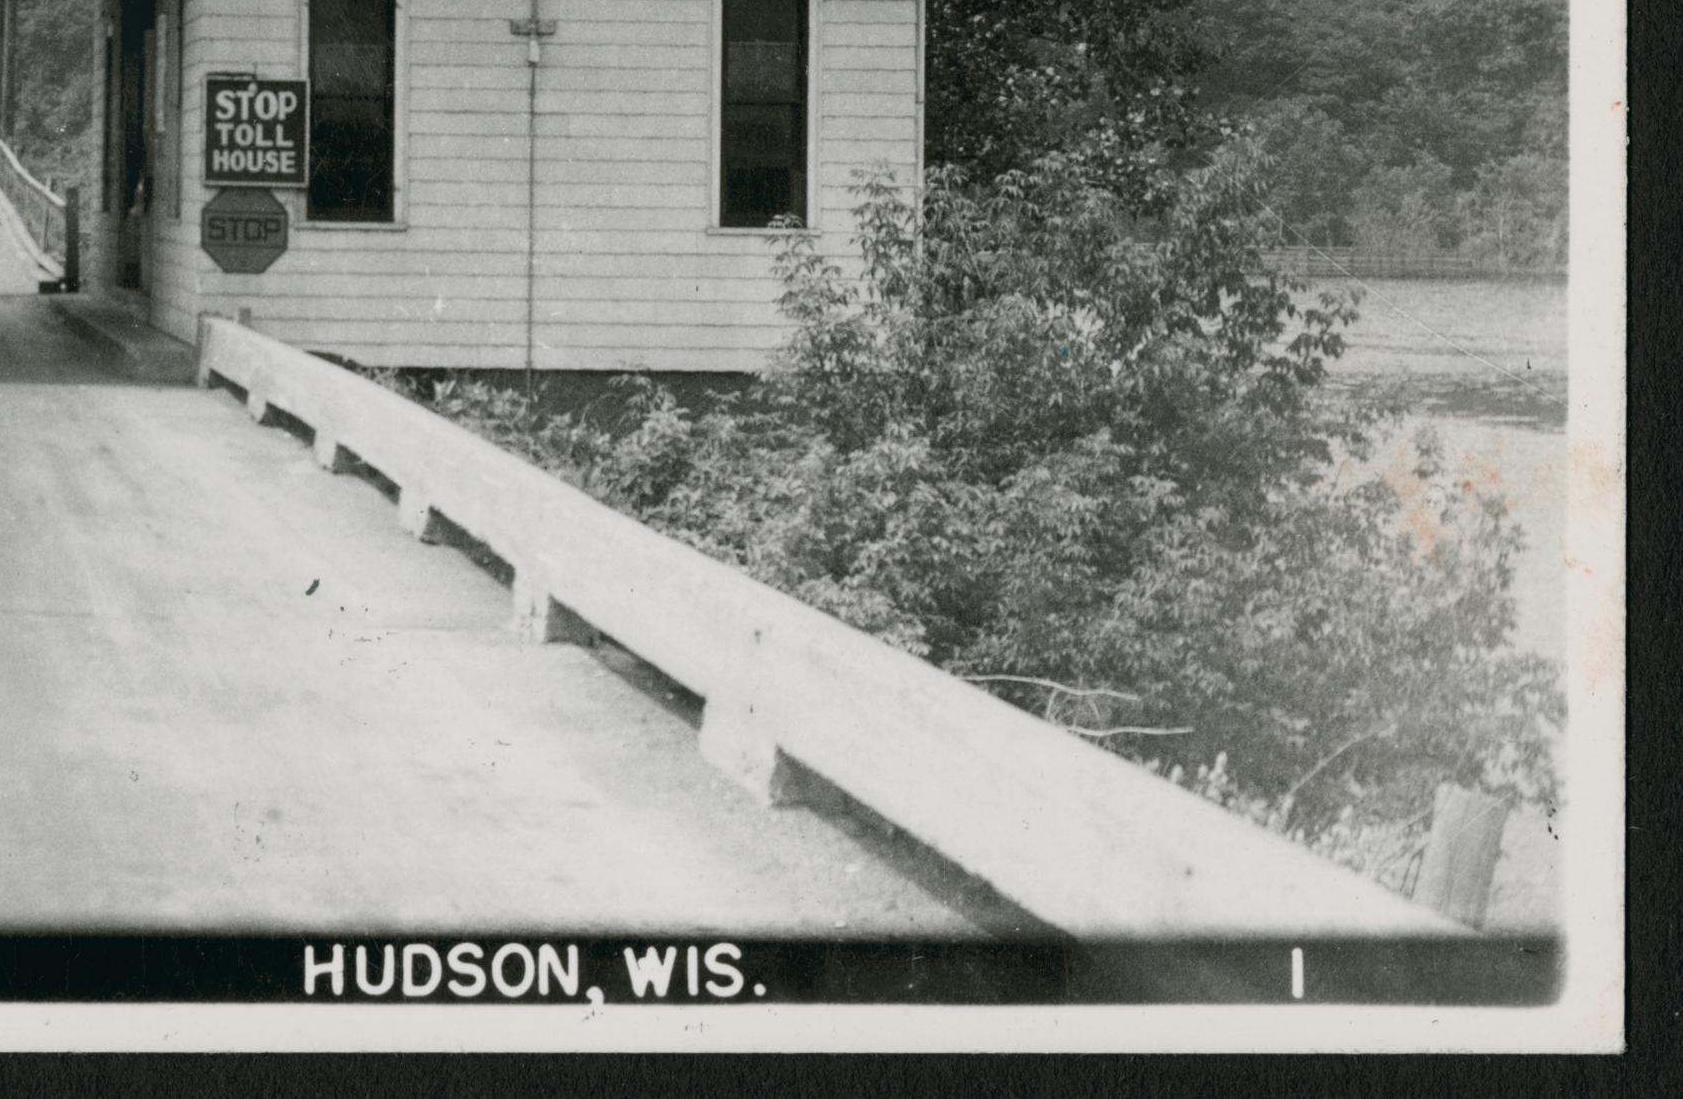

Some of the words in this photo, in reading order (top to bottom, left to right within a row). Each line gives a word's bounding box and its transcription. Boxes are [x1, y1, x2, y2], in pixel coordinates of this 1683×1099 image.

[215, 89, 298, 121] STOP
[214, 123, 294, 147] TOLL
[213, 149, 296, 173] HOUSE
[208, 216, 280, 241] STOP
